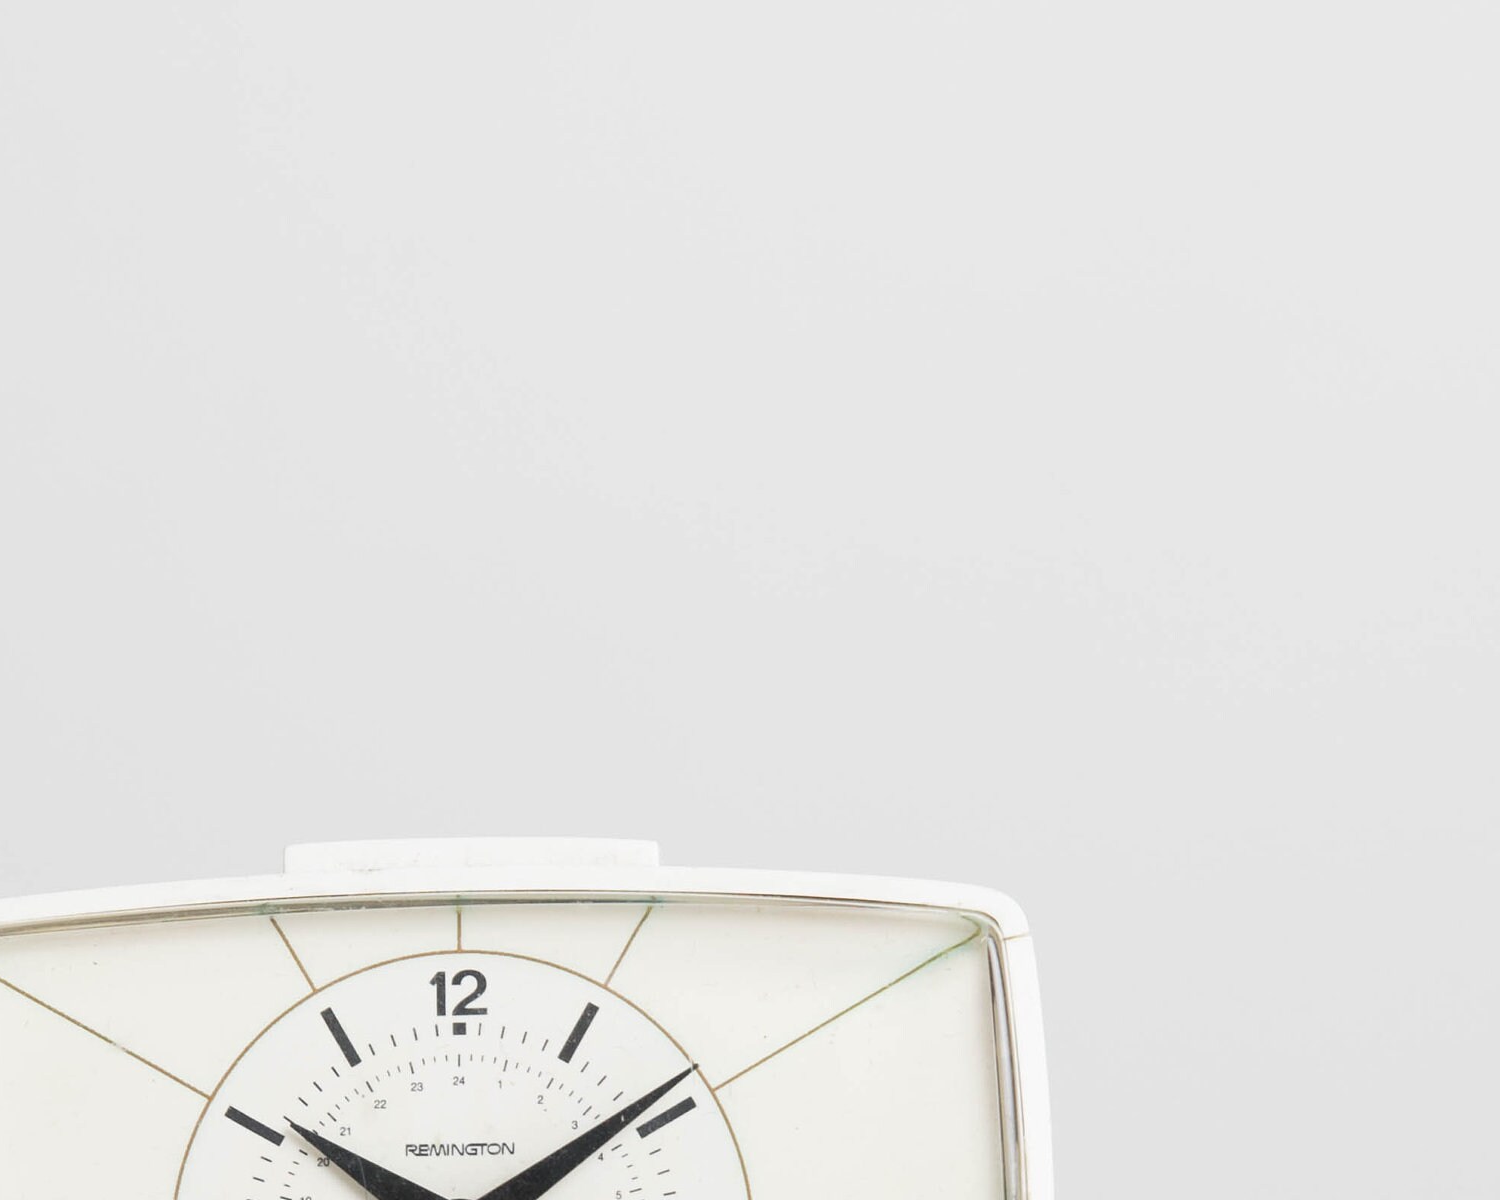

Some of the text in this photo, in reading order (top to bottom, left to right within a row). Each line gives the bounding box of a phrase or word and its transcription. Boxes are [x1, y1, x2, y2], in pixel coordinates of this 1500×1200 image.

[430, 970, 487, 1016] 12
[410, 1081, 424, 1092] 23
[452, 1076, 465, 1086] 24
[373, 1099, 387, 1110] 22
[537, 1094, 544, 1105] 2
[571, 1120, 579, 1130] 3
[339, 1126, 351, 1137] 21
[406, 1143, 514, 1156] REMINGTON
[316, 1156, 331, 1168] 20
[597, 1152, 605, 1161] 4
[615, 1190, 622, 1200] 5
